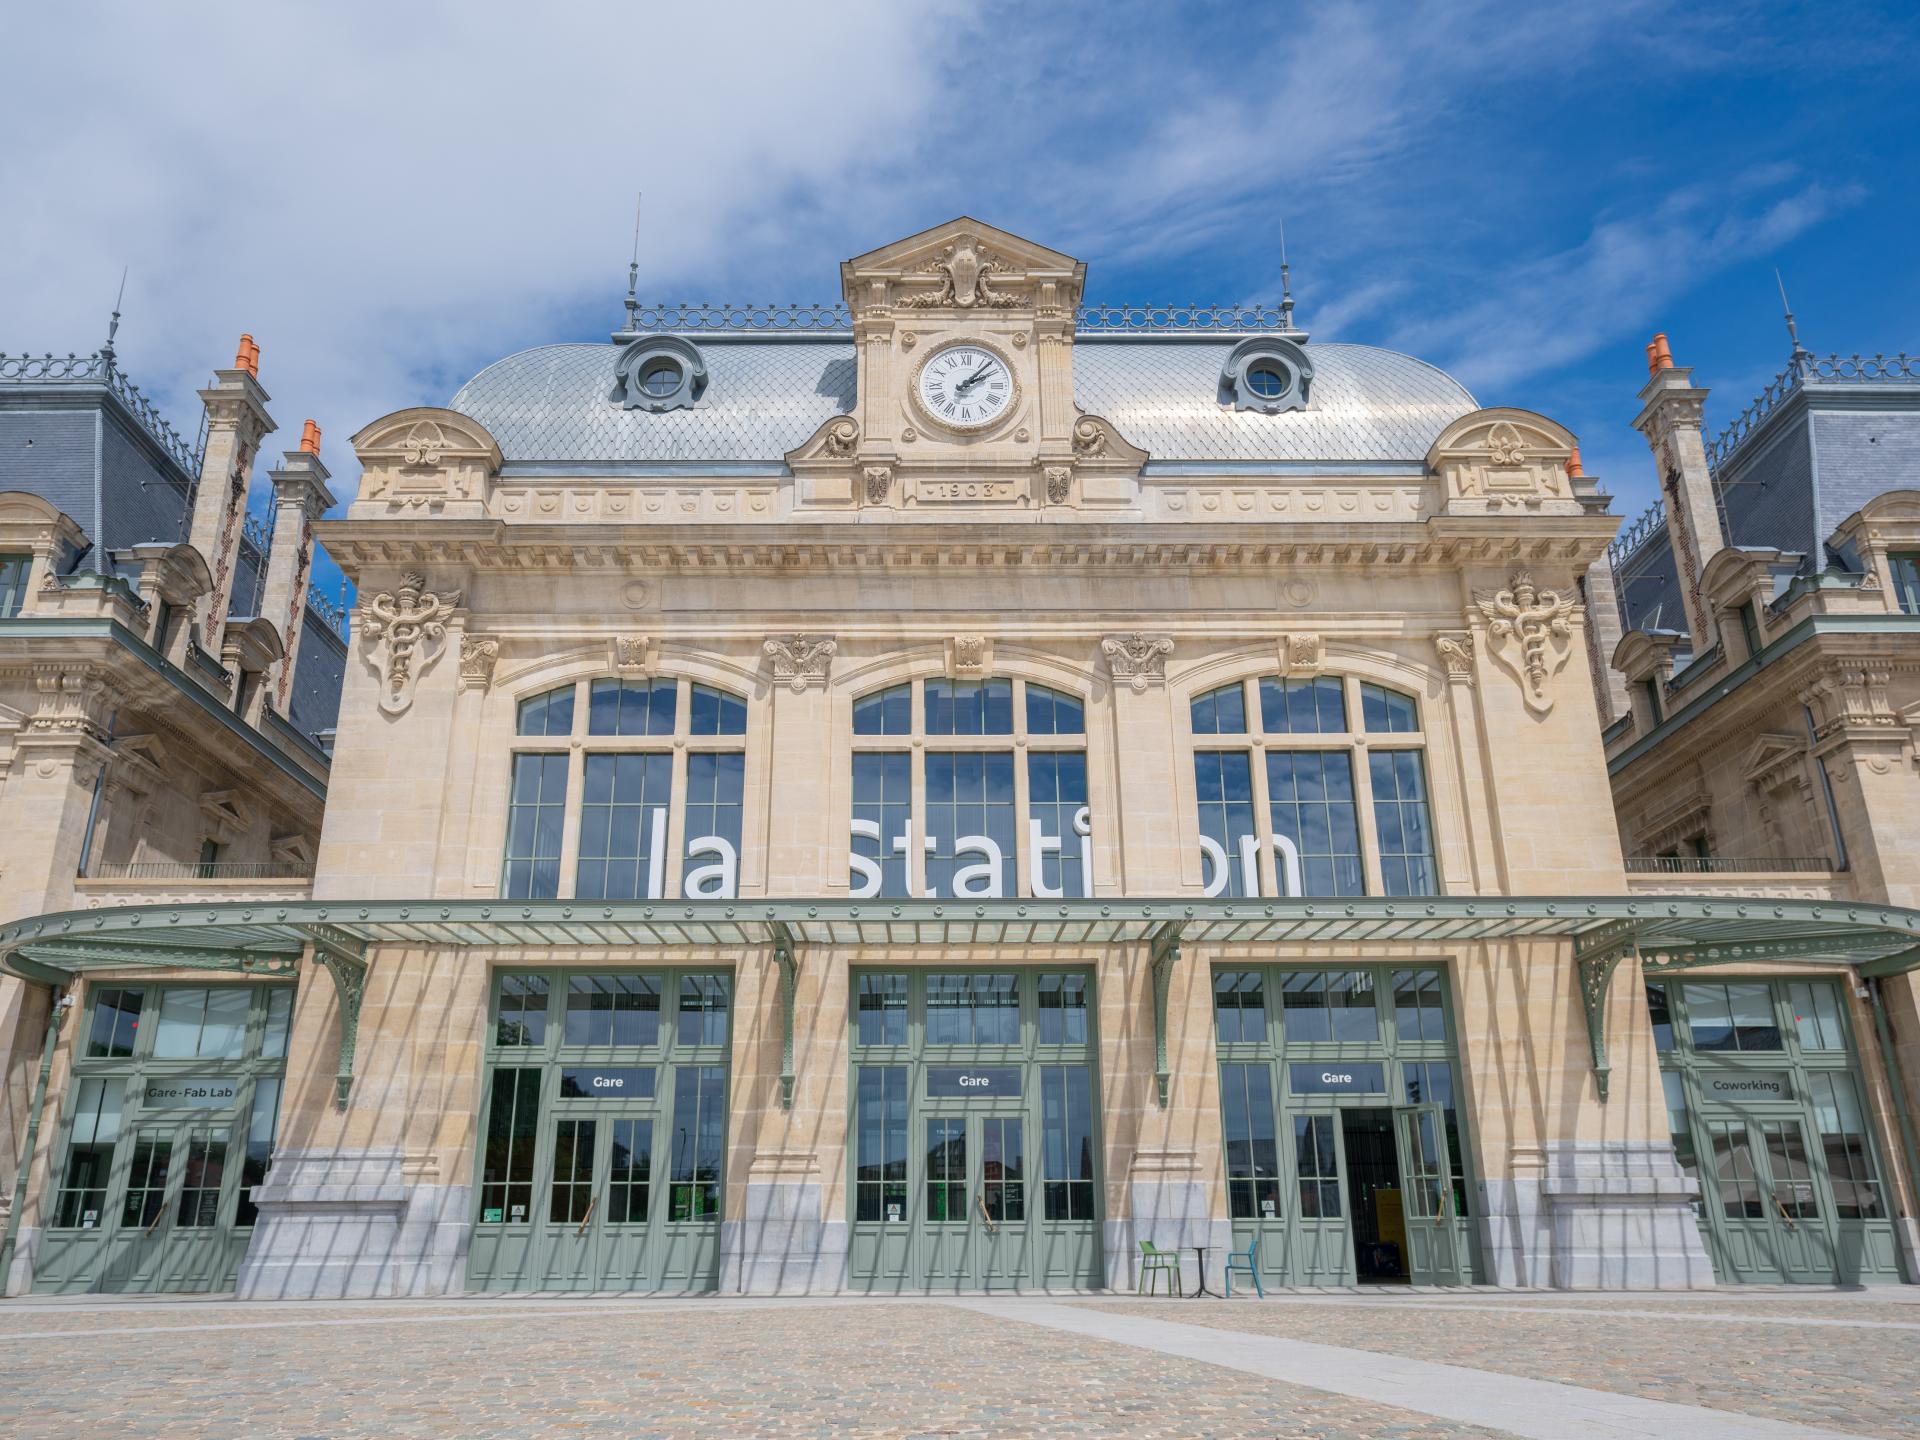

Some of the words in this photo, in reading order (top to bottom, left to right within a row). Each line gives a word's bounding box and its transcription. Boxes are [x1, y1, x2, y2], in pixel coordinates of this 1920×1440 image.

[945, 357, 957, 369] XI
[961, 355, 972, 366] XII
[933, 368, 946, 377] X
[929, 382, 942, 390] IX
[962, 407, 971, 418] VI
[979, 405, 987, 415] V
[939, 484, 994, 498] 1903
[647, 808, 737, 899] la
[593, 1076, 624, 1088] Gare
[959, 1075, 990, 1087] Gare
[1321, 1072, 1352, 1083] Gare
[1713, 1080, 1780, 1092] Coworking
[210, 1088, 233, 1098] Lab
